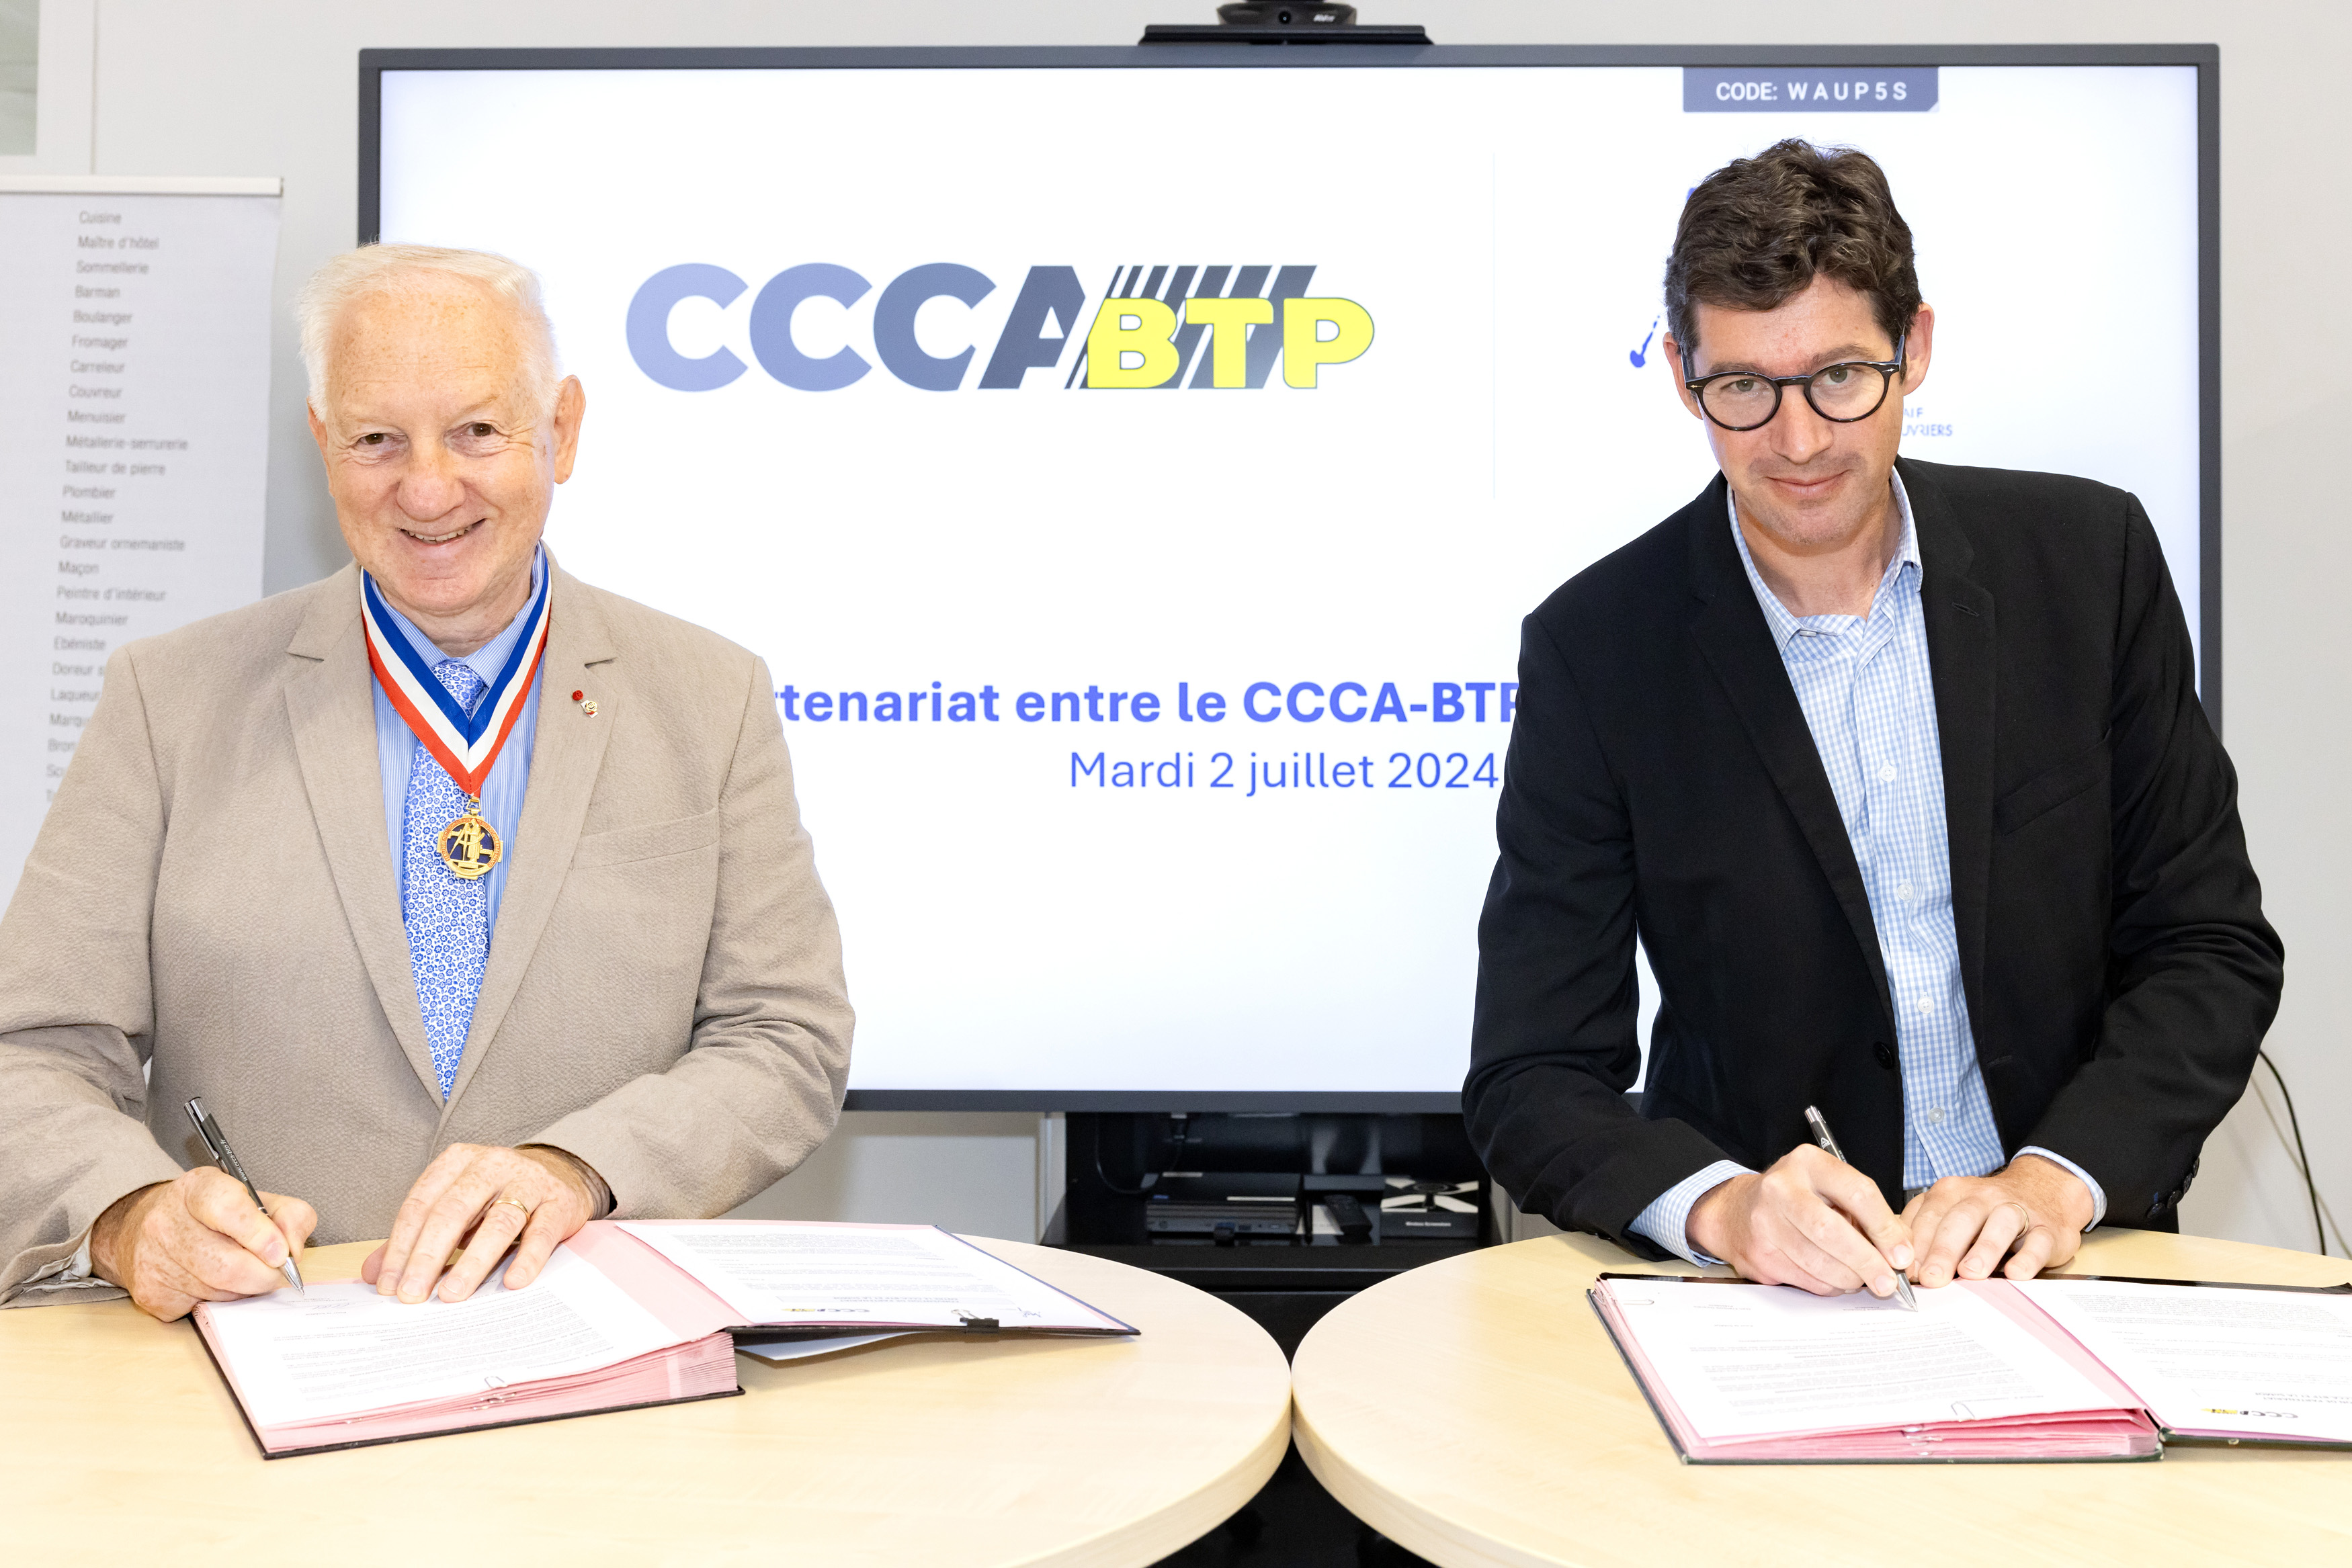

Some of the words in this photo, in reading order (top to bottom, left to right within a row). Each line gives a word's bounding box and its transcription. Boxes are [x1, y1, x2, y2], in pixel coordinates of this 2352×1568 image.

[1716, 82, 1777, 101] CODE:
[79, 211, 122, 224] Cuisine
[77, 260, 149, 274] Sommellerie
[75, 285, 120, 299] Barman
[73, 310, 132, 326] Boulanger
[626, 262, 1086, 392] CCCA
[1087, 298, 1374, 388] BTP
[72, 335, 128, 351] Fromager
[71, 359, 125, 374] Carreleur
[69, 384, 122, 399] Couvreur
[67, 410, 126, 424] Menuisier
[1902, 424, 1953, 437] UVRIERS
[66, 460, 108, 474] Tailleur
[112, 462, 126, 474] de
[130, 464, 166, 476] pierre
[62, 485, 116, 499] Plombier
[60, 535, 108, 550] Graveur
[56, 586, 100, 600] Peintre
[55, 611, 128, 626] Maroquinier
[52, 662, 93, 676] Doreur
[775, 681, 1000, 723] tenariat
[1015, 685, 1161, 723] entre
[1178, 682, 1226, 723] le
[1243, 681, 1519, 724] CCCA-BTP
[1071, 751, 1193, 788] Mardi
[1210, 752, 1234, 788] 2
[1246, 752, 1374, 797] juillet
[1388, 752, 1499, 789] 2024
